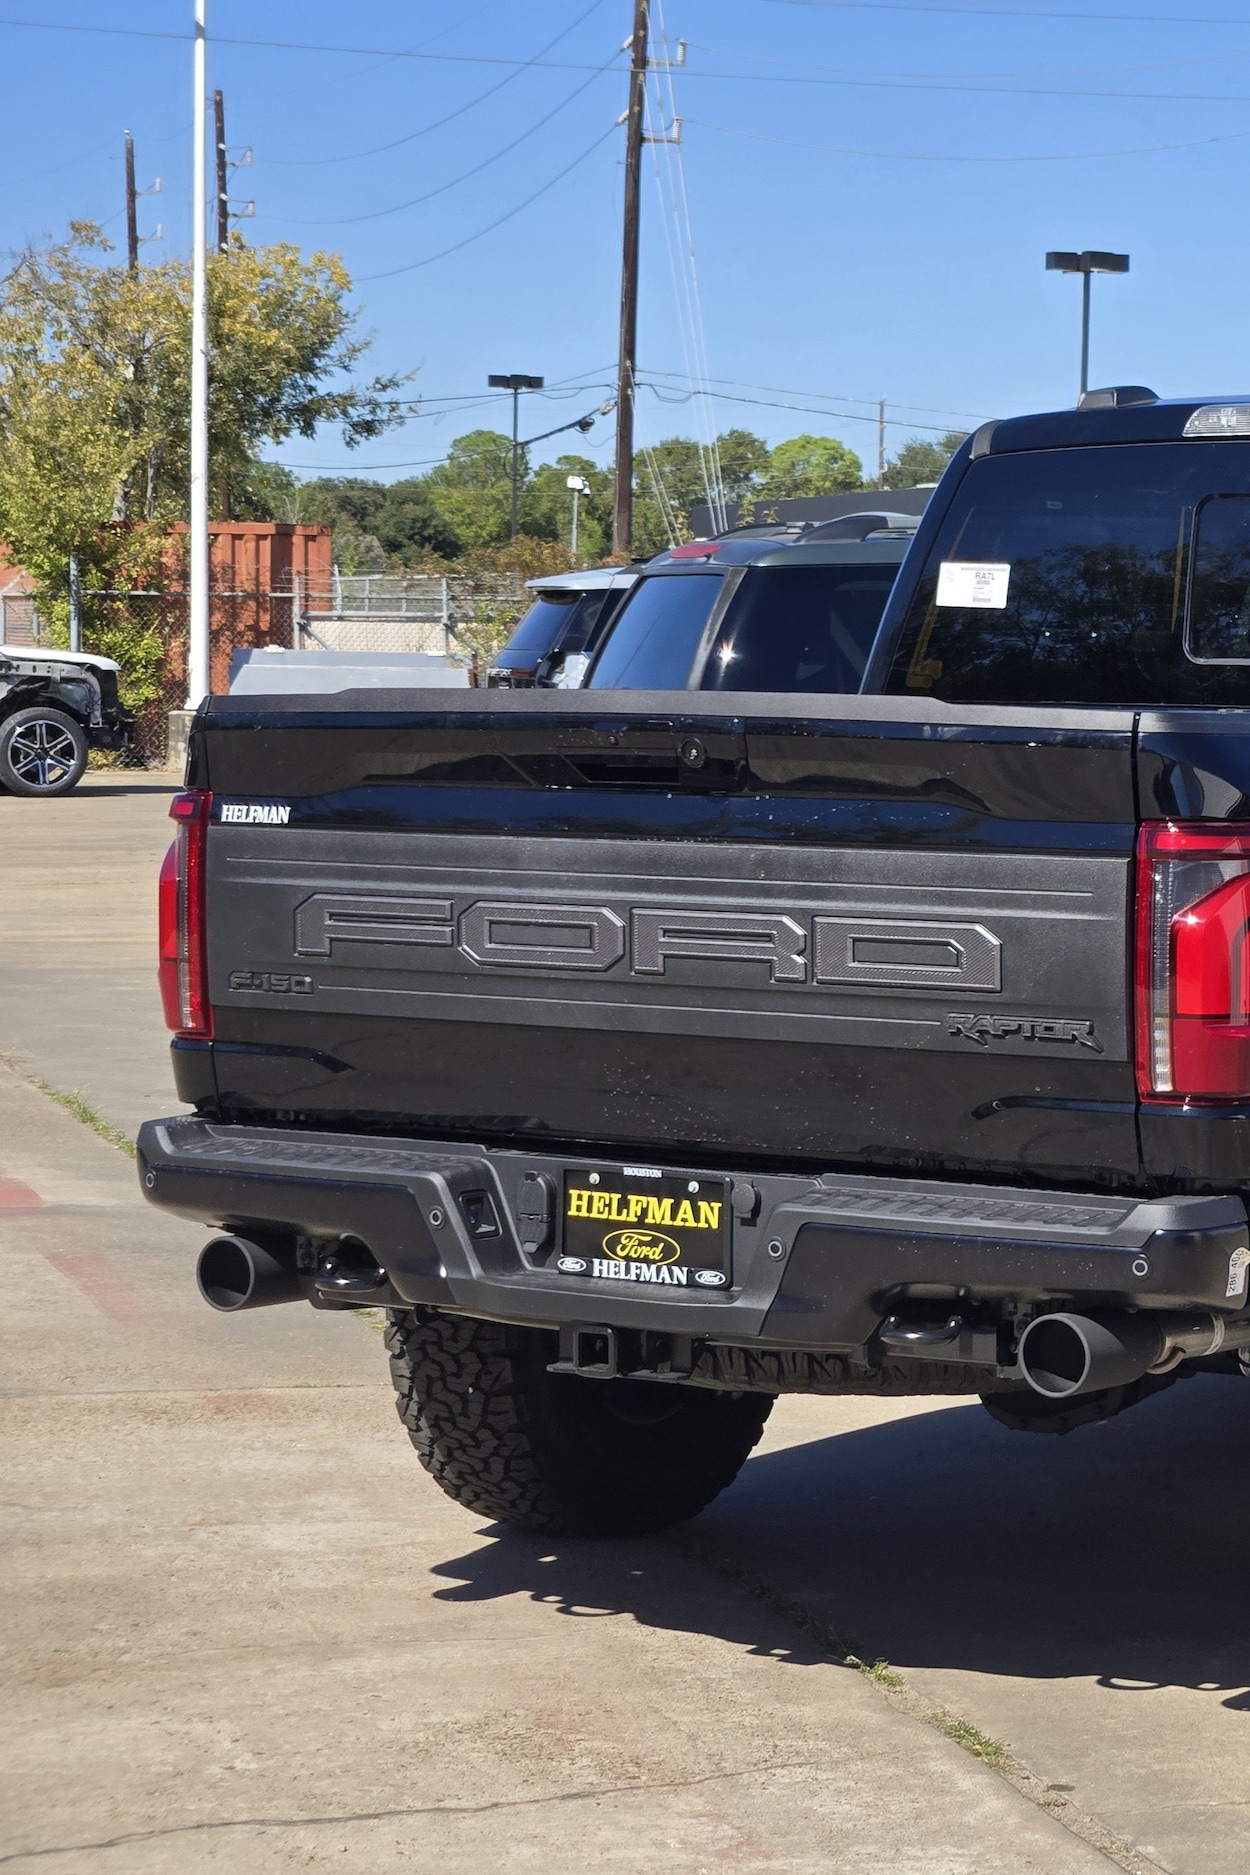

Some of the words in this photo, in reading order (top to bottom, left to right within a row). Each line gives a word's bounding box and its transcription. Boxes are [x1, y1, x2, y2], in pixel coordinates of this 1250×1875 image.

[221, 804, 291, 824] HELFMAN
[293, 892, 1003, 994] FORD
[229, 971, 314, 996] F-150
[946, 1011, 1104, 1053] RAPTOR
[623, 1167, 662, 1178] HOUSTON
[567, 1189, 722, 1229] HELFMAN
[616, 1232, 665, 1261] Ford
[592, 1258, 689, 1285] HELFMAN
